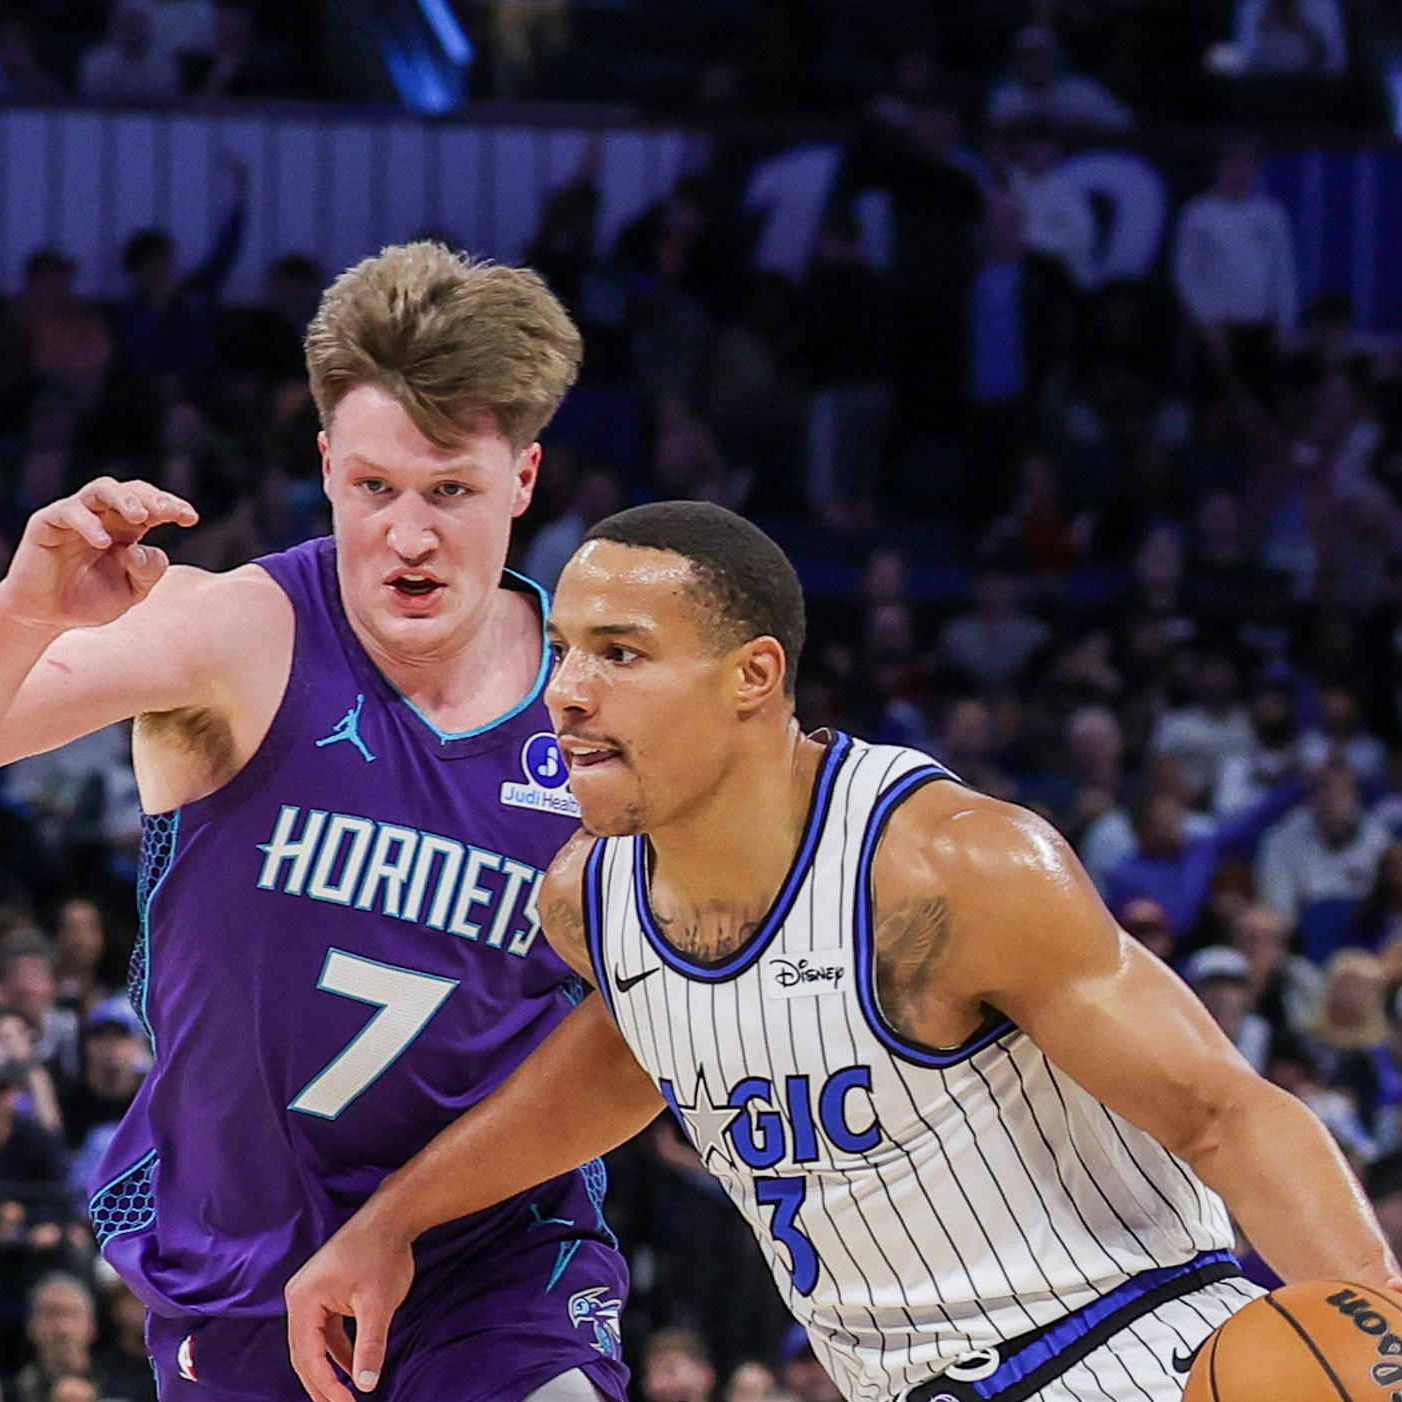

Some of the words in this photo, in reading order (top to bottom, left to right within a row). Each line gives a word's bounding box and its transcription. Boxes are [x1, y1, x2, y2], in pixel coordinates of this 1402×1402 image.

[504, 786, 540, 806] Judi
[286, 946, 462, 1120] 7
[753, 1174, 820, 1298] 3
